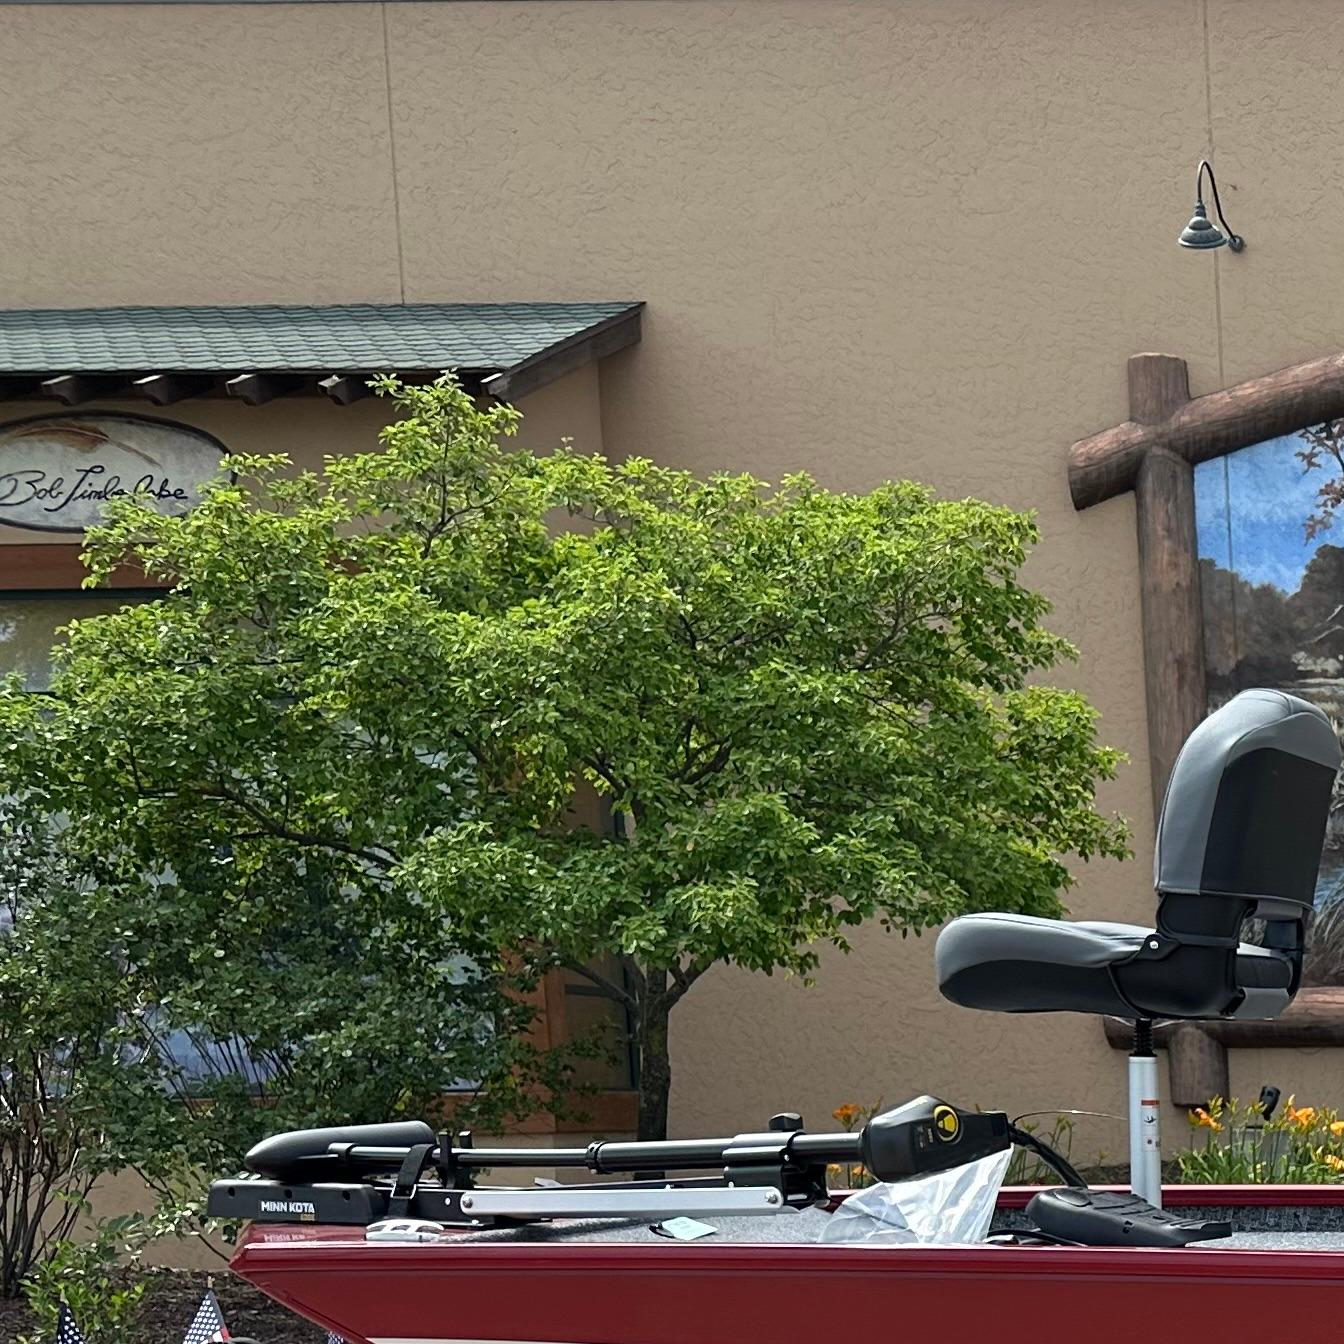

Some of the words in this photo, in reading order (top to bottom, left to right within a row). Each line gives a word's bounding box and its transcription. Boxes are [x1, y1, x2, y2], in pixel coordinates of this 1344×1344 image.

[0, 470, 64, 506] Bob
[44, 465, 189, 512] Timbelake
[260, 1201, 288, 1213] MINN
[289, 1202, 315, 1214] KOTA
